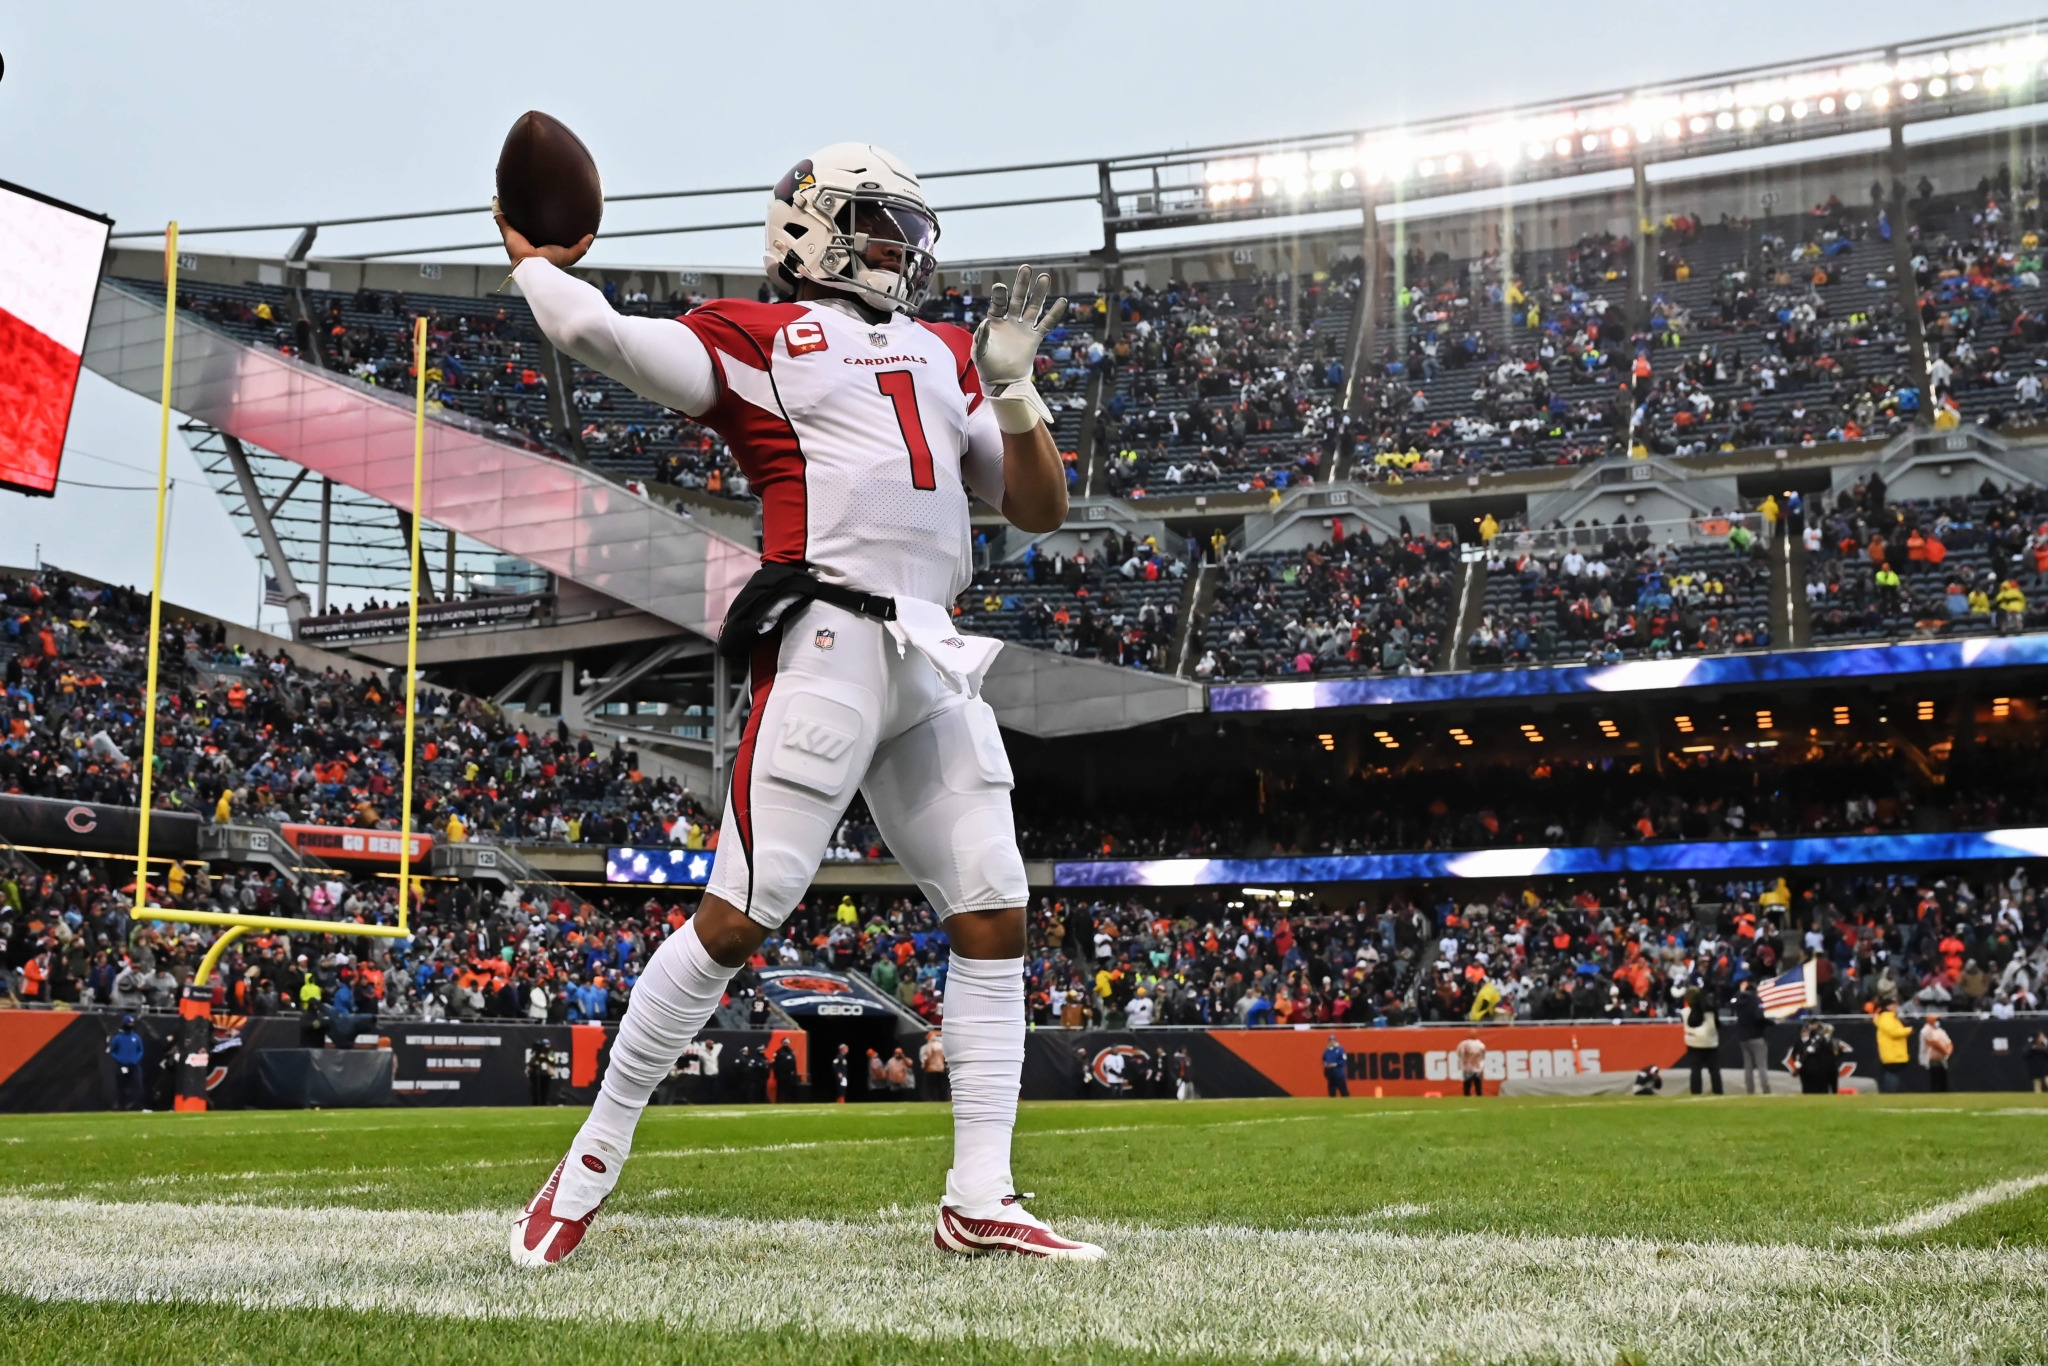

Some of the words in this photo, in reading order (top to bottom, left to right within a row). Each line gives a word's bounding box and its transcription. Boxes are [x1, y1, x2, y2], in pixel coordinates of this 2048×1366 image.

[786, 323, 822, 346] C
[843, 355, 928, 366] CARDINALS
[875, 370, 936, 491] 1
[440, 610, 475, 622] LOCATION
[476, 608, 486, 618] TO
[253, 836, 269, 849] 125
[297, 832, 365, 851] CHICAGO
[368, 836, 420, 855] BEAS
[817, 1005, 863, 1016] GEICO
